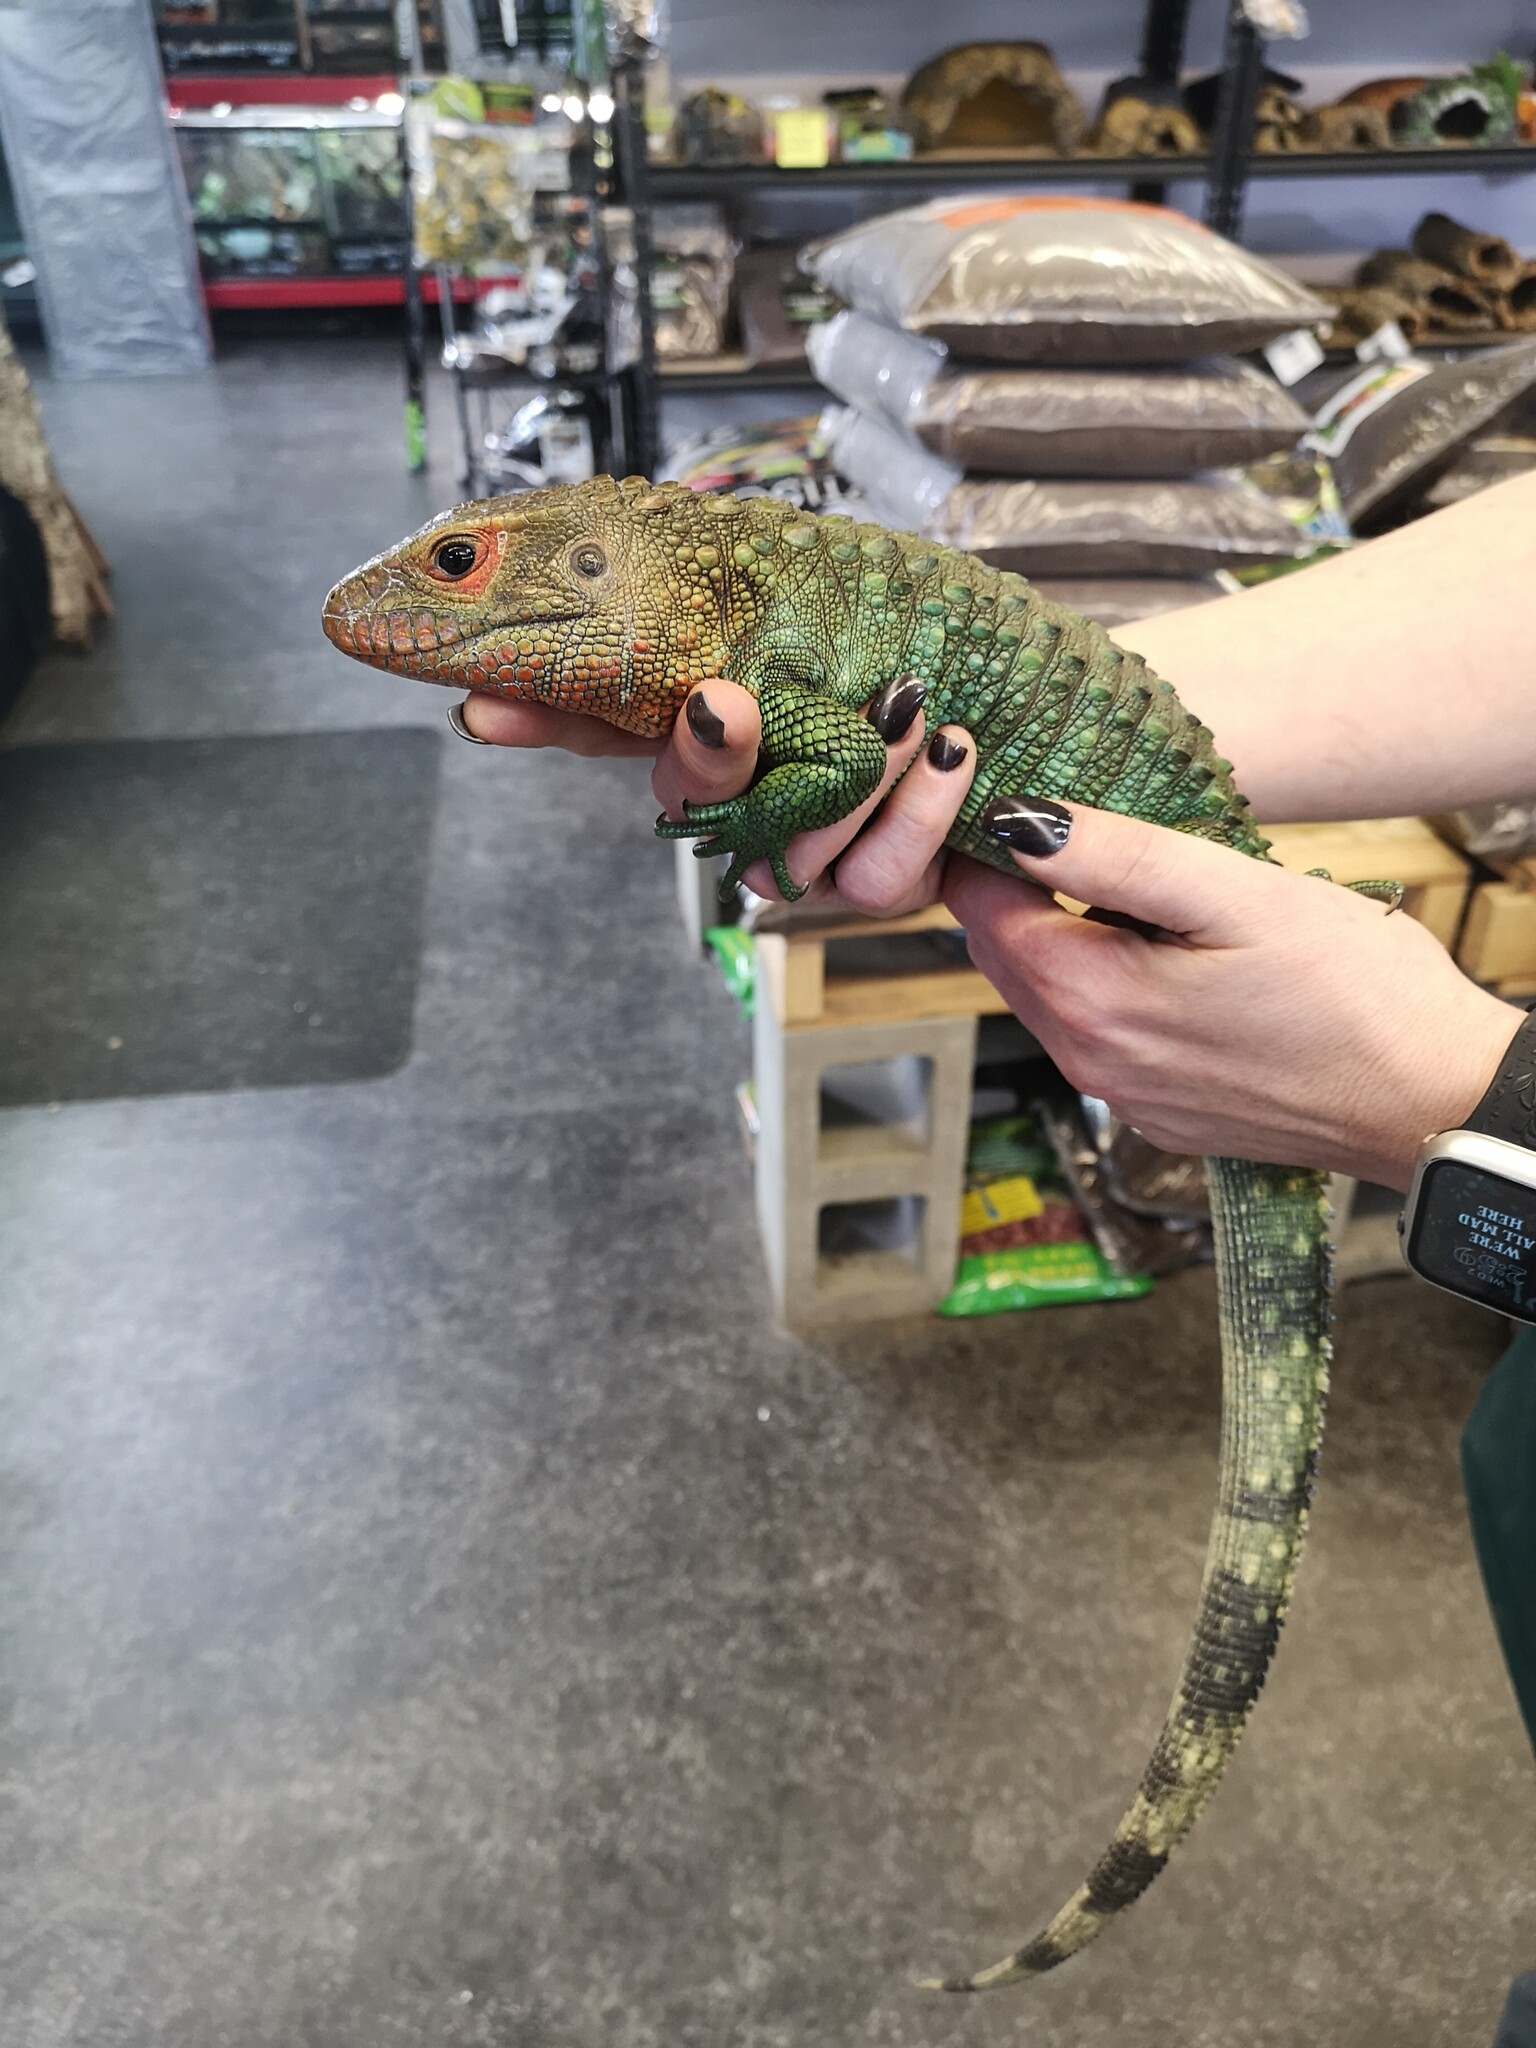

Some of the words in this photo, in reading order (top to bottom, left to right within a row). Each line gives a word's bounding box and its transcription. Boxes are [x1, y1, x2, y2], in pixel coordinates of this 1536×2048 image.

[1457, 1213, 1499, 1237] MAD
[1476, 1205, 1524, 1231] HERE
[1468, 1231, 1521, 1261] WE'RE
[1502, 1229, 1536, 1251] ALL
